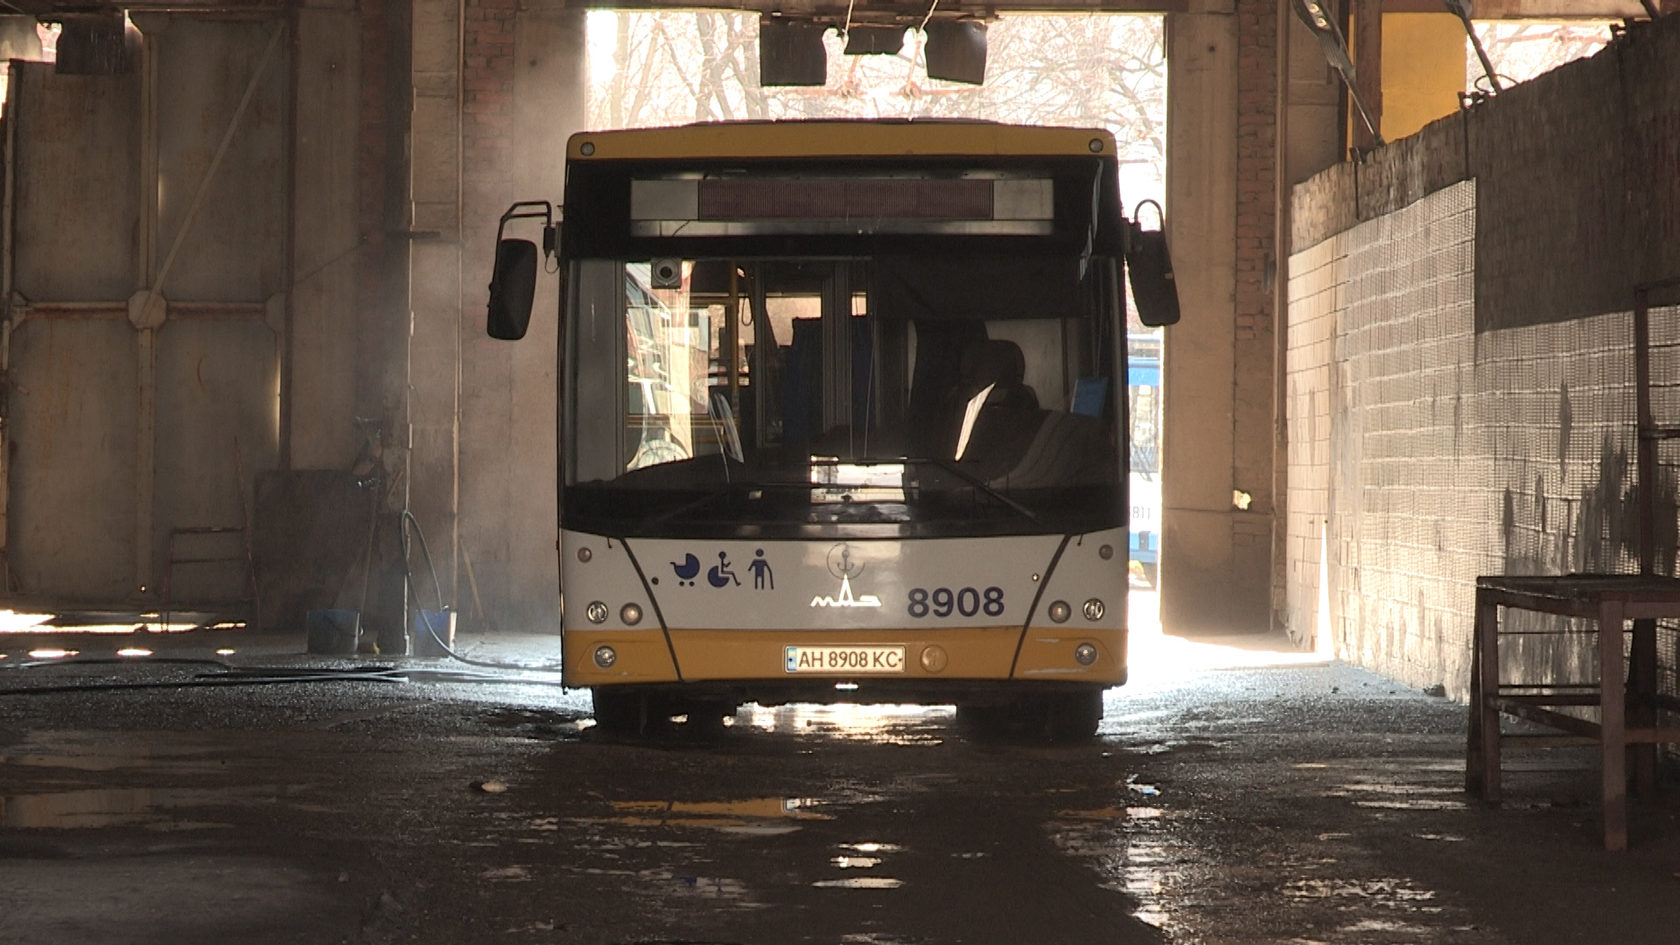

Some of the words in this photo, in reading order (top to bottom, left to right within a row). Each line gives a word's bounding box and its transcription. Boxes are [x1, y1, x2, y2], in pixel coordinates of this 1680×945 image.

[907, 586, 1005, 618] 8908
[799, 651, 823, 667] AH
[829, 651, 868, 667] 8908
[873, 651, 898, 667] KC
